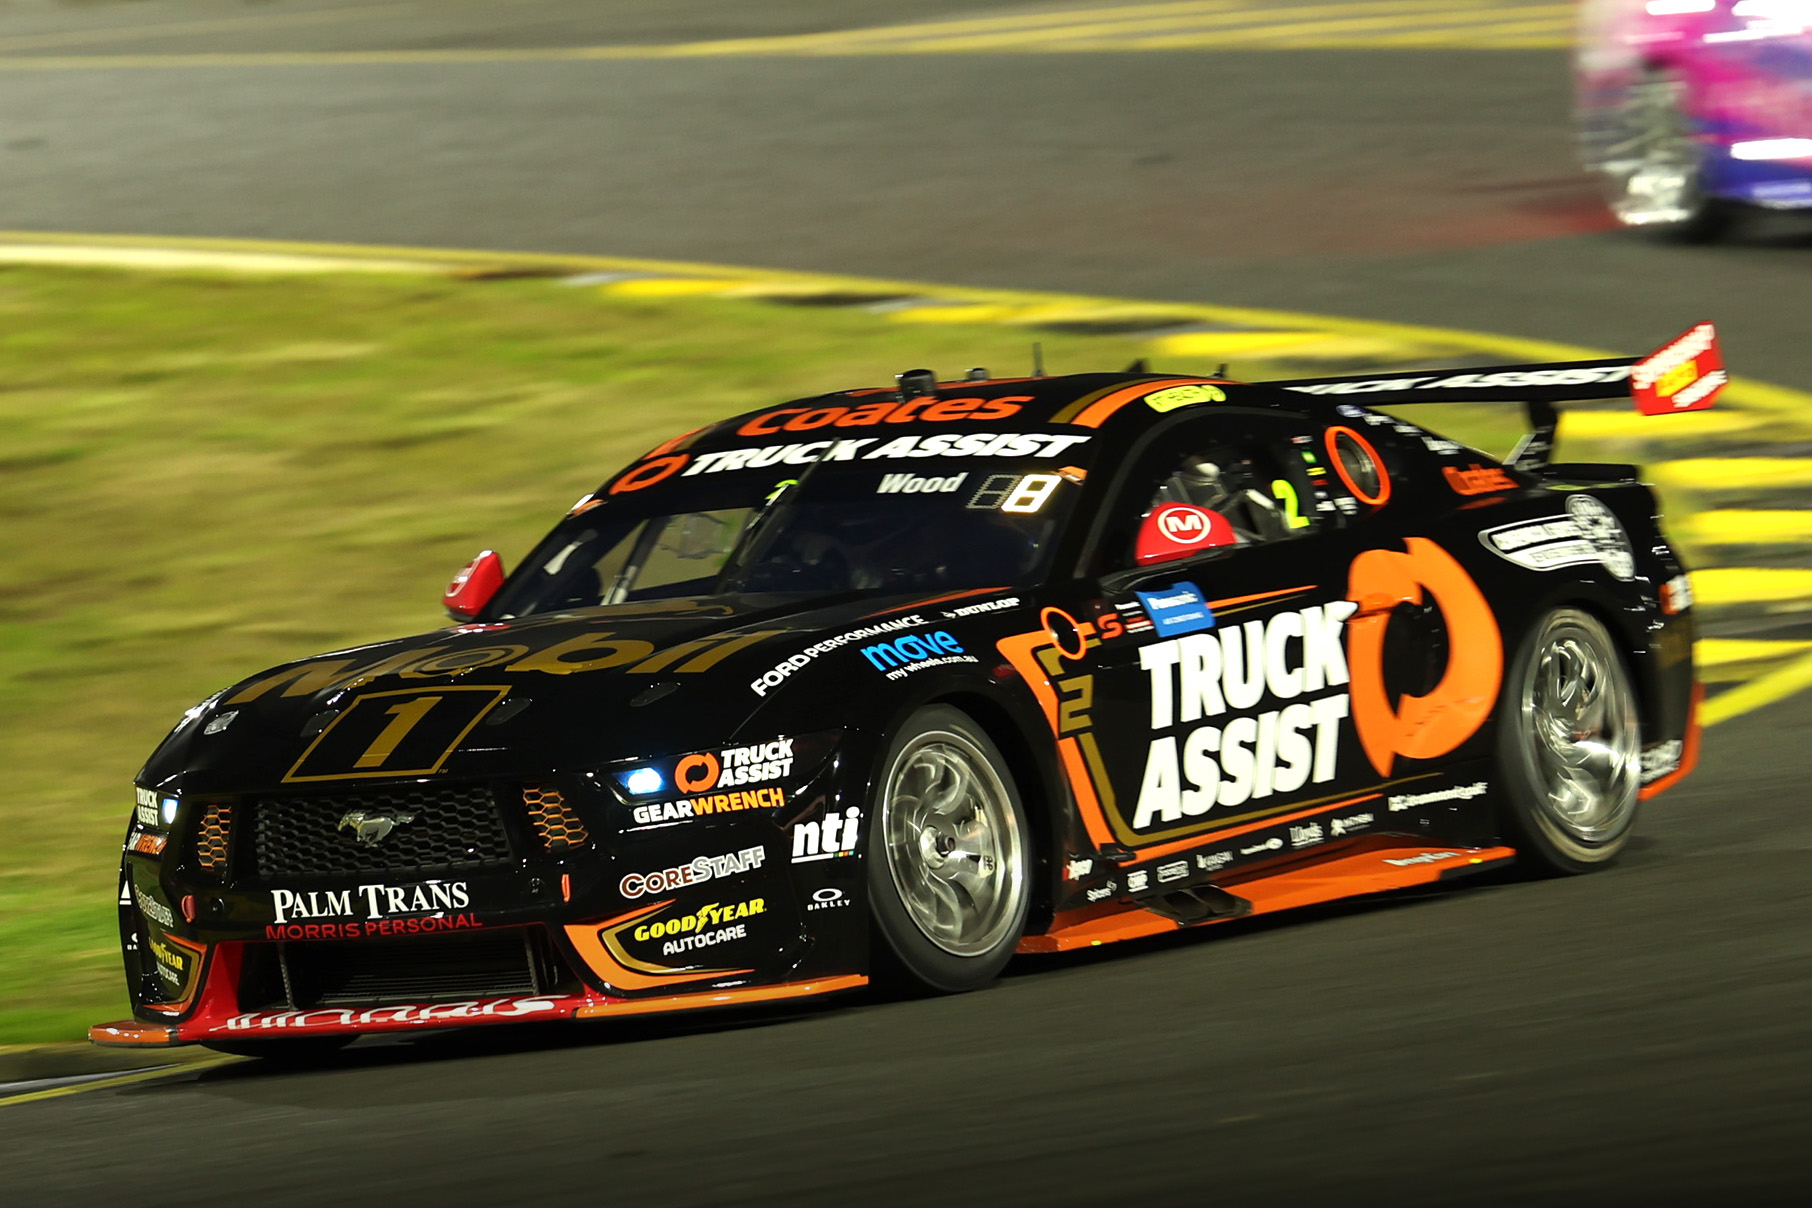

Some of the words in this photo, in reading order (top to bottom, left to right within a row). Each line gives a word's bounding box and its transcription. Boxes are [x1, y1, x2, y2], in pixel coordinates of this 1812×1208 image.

[681, 437, 880, 477] TRUCK
[861, 433, 1092, 459] ASSIST
[876, 471, 970, 494] Wood
[1272, 479, 1310, 528] 2
[1165, 514, 1203, 533] M
[953, 597, 1020, 617] DUNLOP
[224, 631, 782, 705] Mobil
[750, 653, 811, 697] FORD
[803, 614, 929, 658] PERFORMANCE
[860, 630, 964, 672] move
[1138, 600, 1359, 730] TRUCK
[352, 696, 444, 768] 1
[717, 758, 793, 788] ASSIST
[721, 738, 793, 769] TRUCK
[1132, 694, 1350, 829] ASSIST
[633, 787, 785, 824] GEARWRENCH
[792, 806, 860, 856] nti
[271, 884, 353, 924] PALM
[359, 881, 470, 919] TRANS
[634, 898, 766, 942] GOODYEAR
[807, 899, 850, 911] OAKLEY
[265, 922, 360, 940] MORRIS
[364, 912, 484, 937] PERSONAL
[662, 924, 747, 956] AUTOCARE
